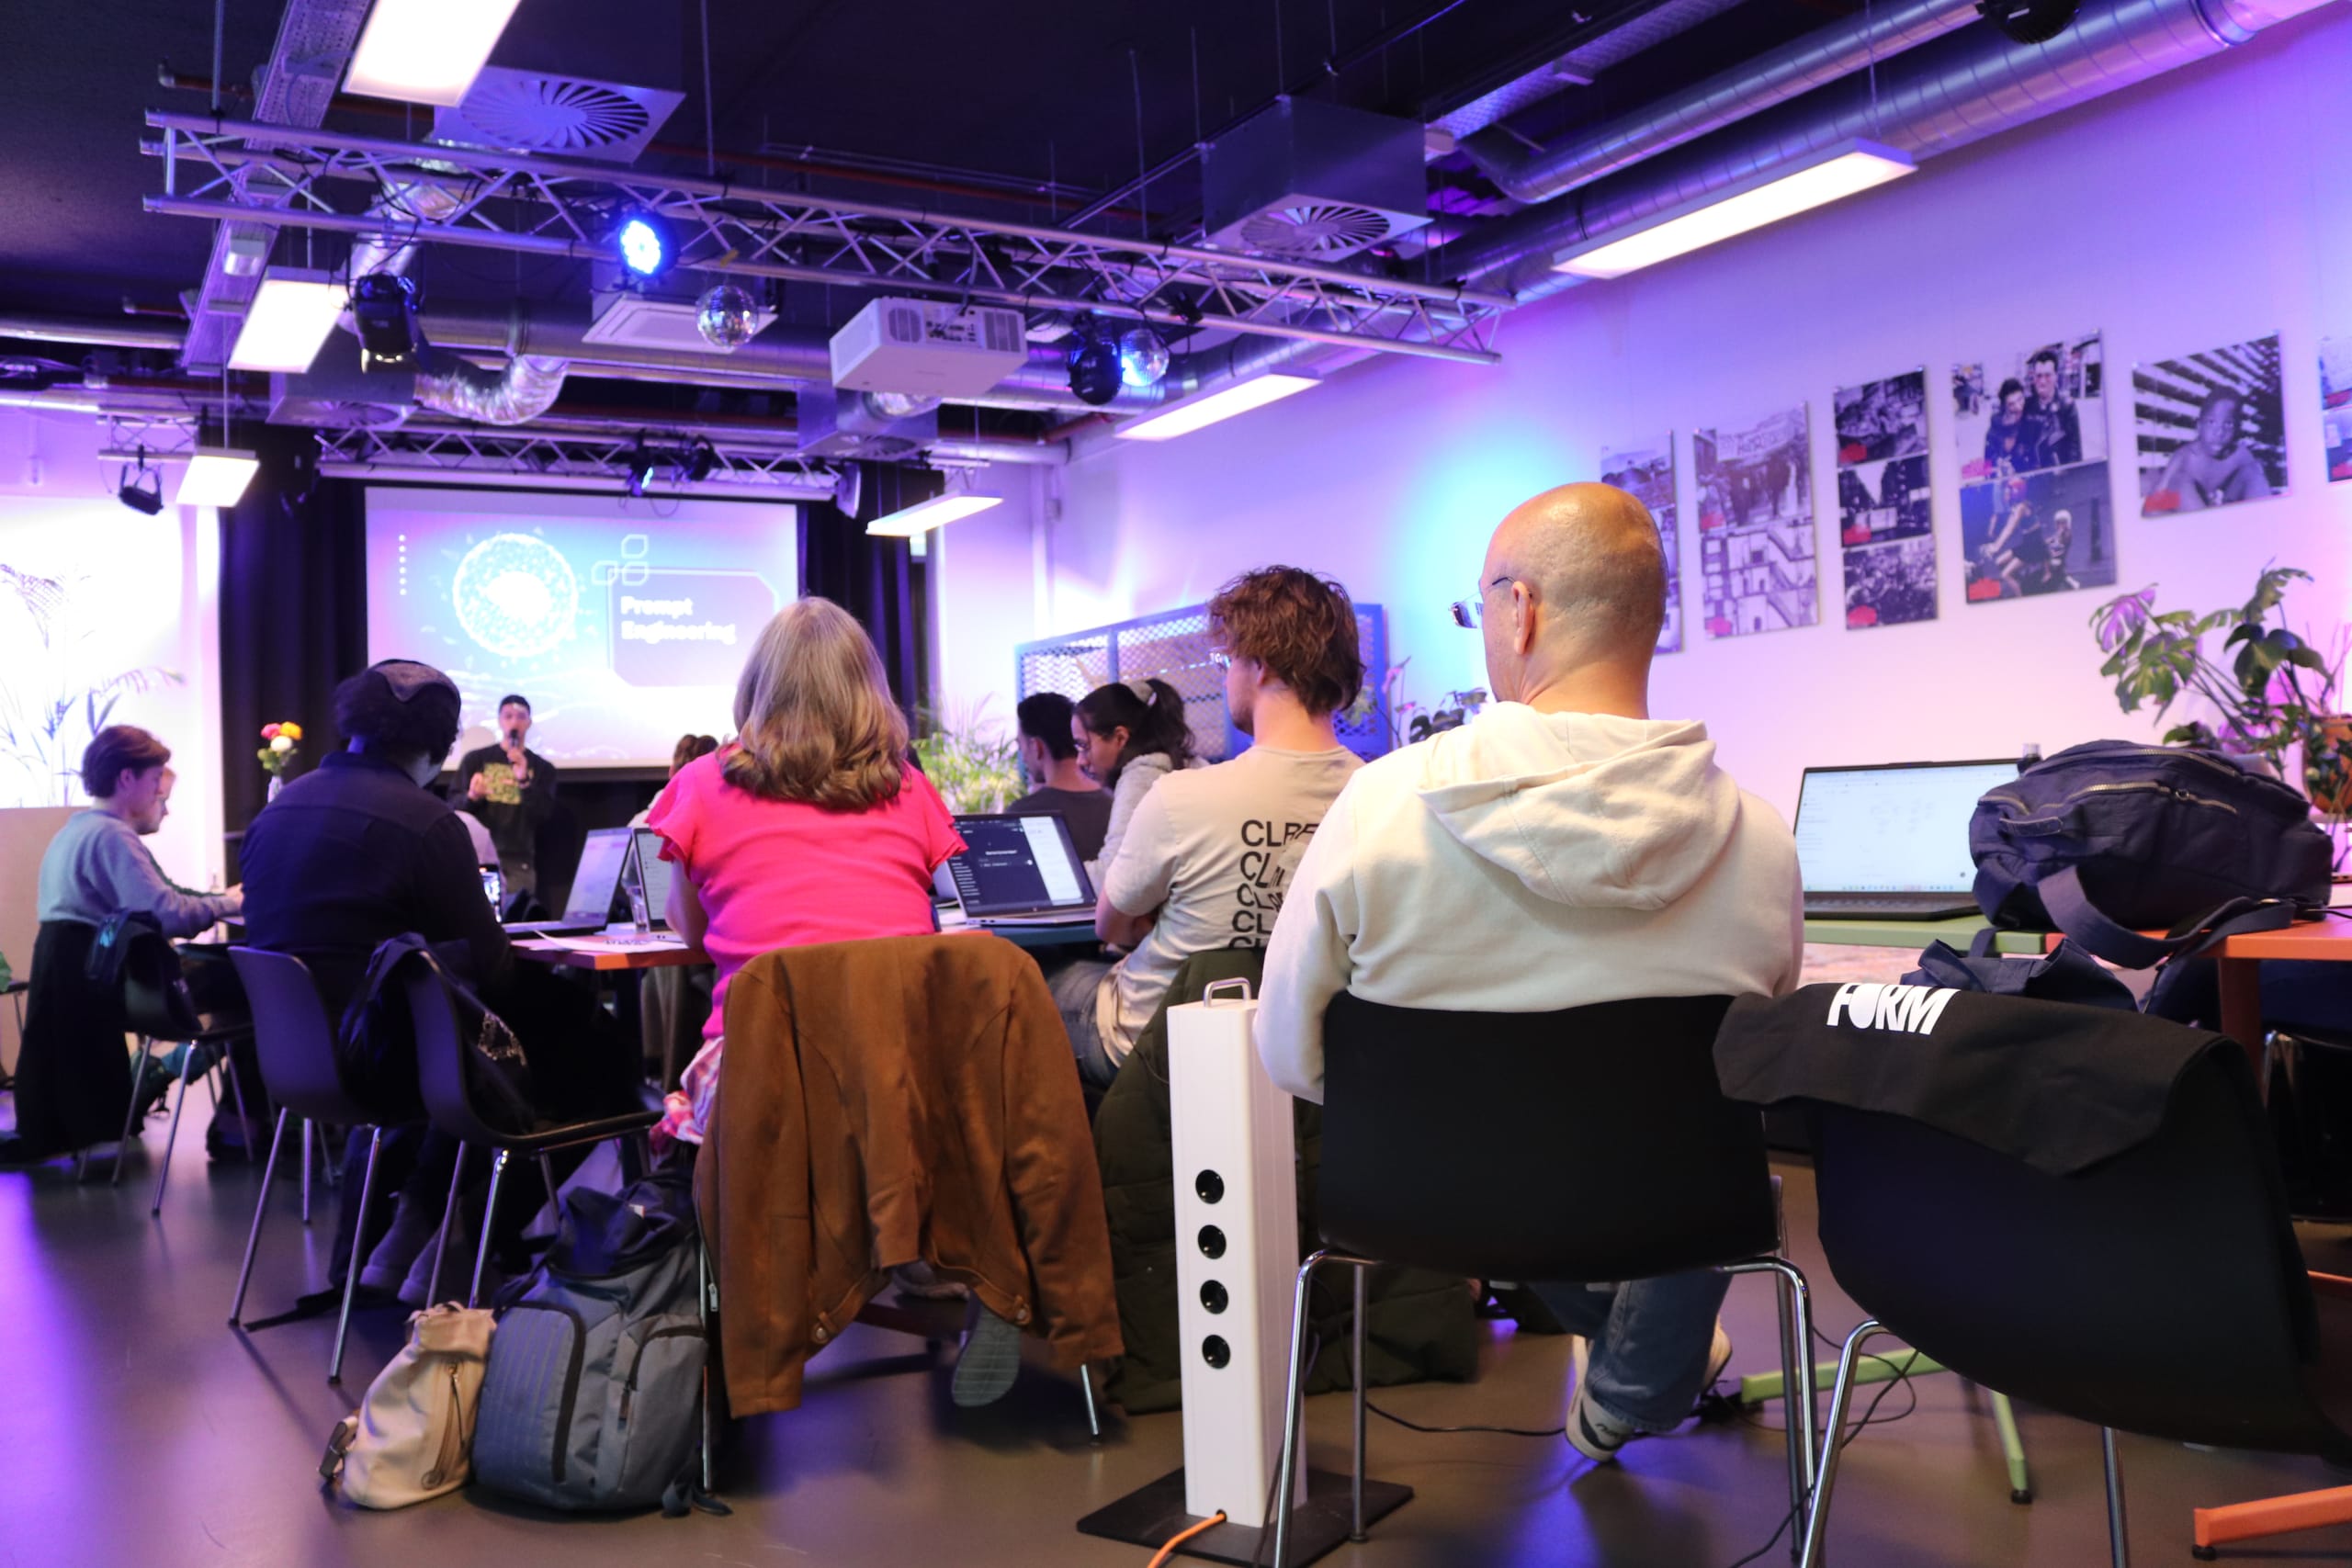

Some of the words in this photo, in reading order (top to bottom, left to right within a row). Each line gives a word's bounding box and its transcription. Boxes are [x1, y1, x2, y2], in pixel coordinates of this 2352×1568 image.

[621, 596, 693, 619] Prompt
[622, 620, 737, 645] Engineering
[1826, 982, 1962, 1035] FORM
